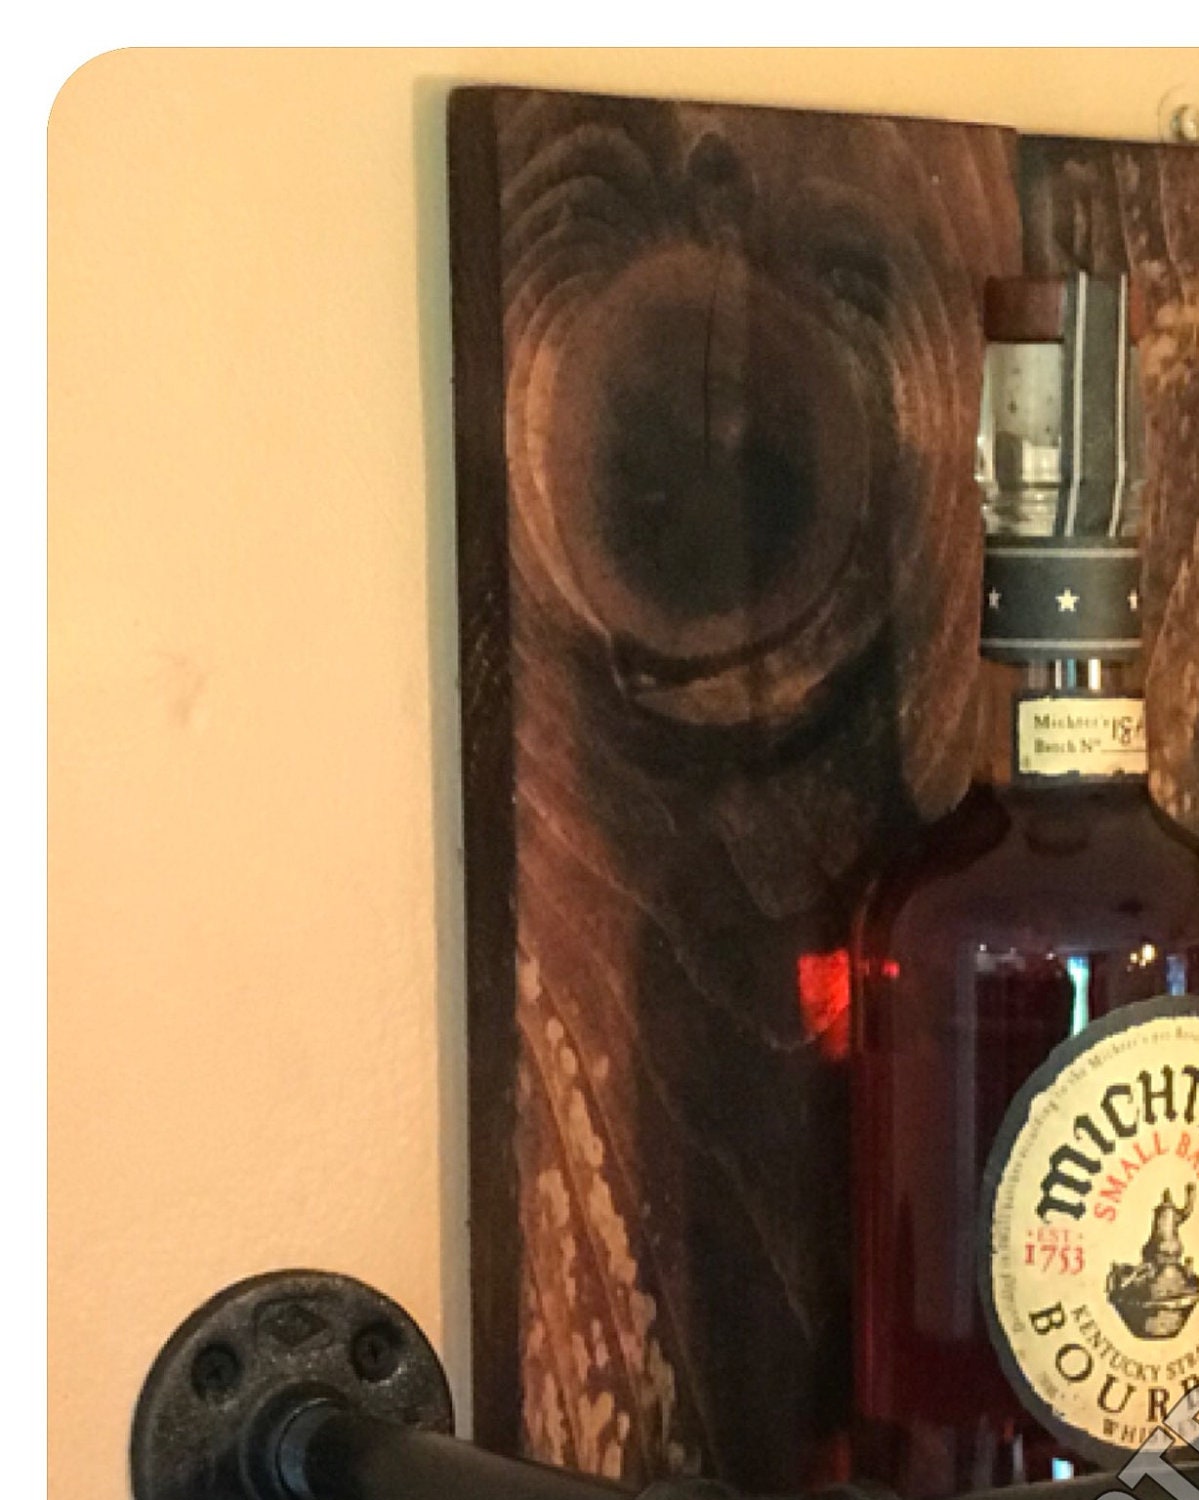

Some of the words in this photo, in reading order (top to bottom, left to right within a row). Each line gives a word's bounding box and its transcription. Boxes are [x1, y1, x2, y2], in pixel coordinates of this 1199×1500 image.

[1093, 1131, 1169, 1223] SMALL
[1025, 1243, 1084, 1275] 1753
[1070, 1303, 1161, 1381] KENTUCKY
